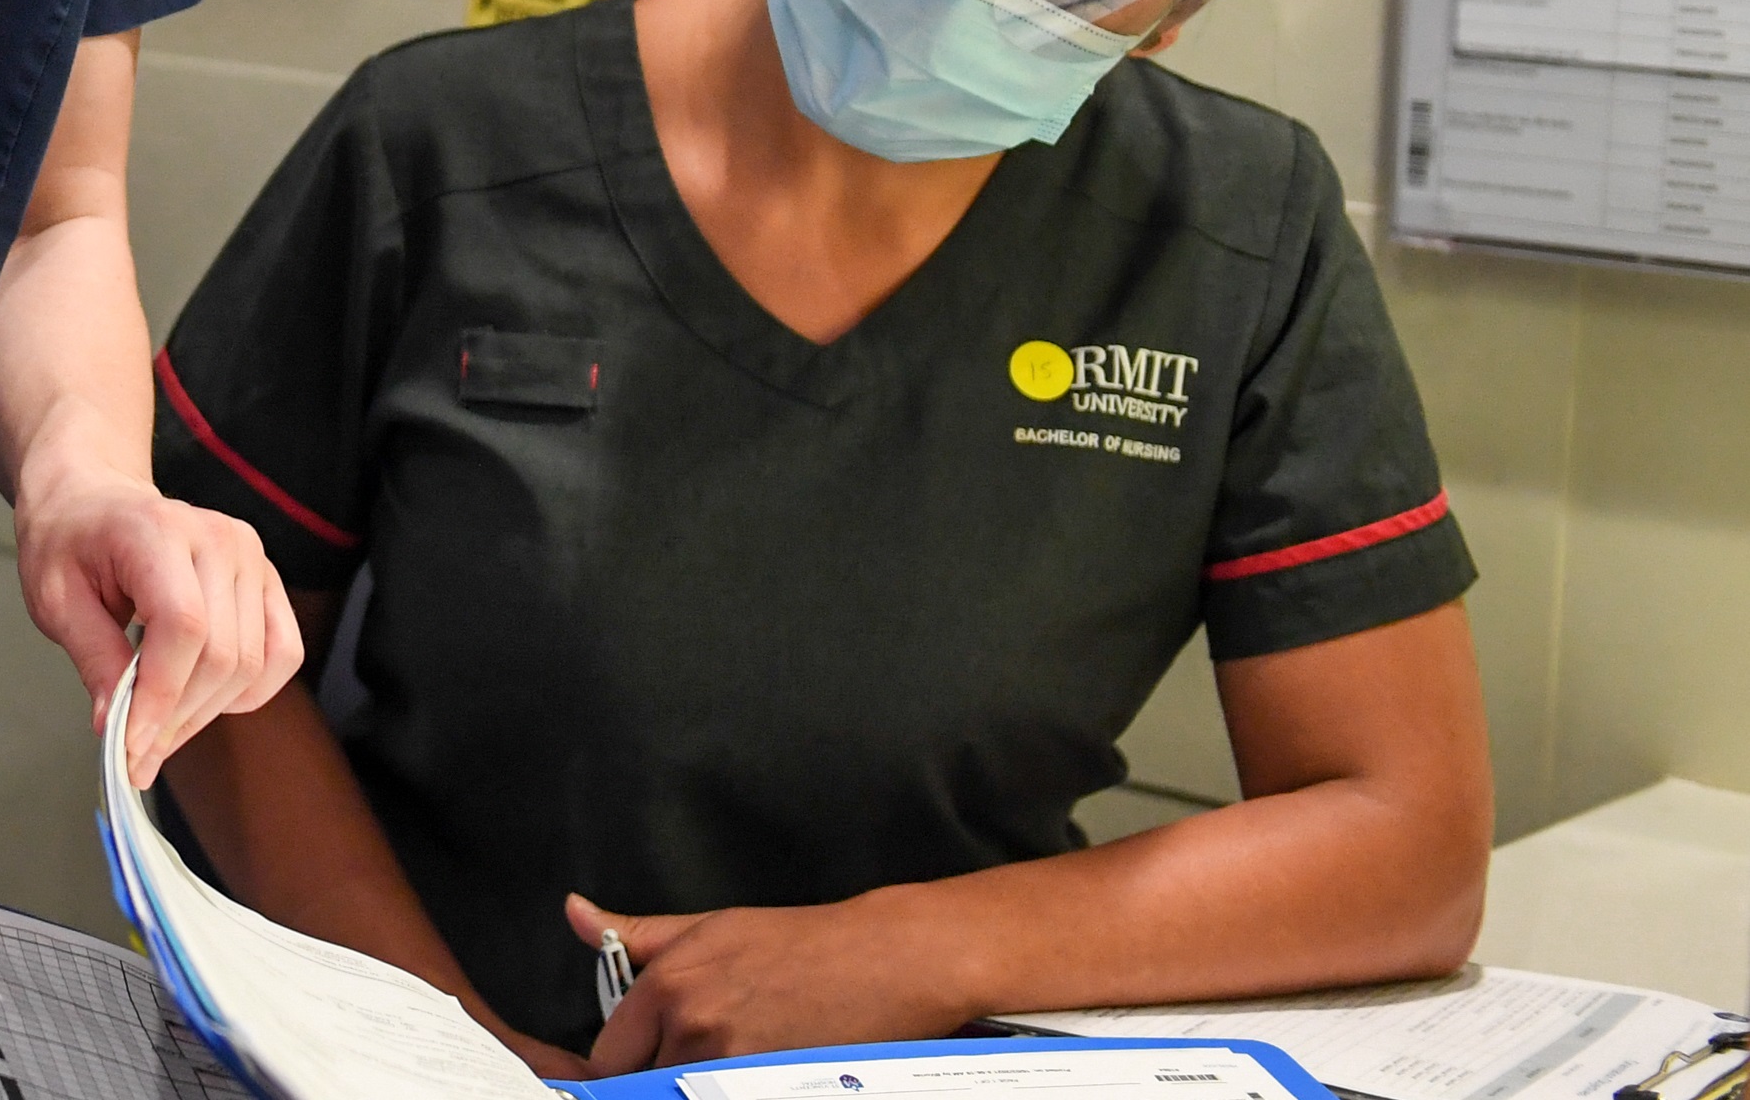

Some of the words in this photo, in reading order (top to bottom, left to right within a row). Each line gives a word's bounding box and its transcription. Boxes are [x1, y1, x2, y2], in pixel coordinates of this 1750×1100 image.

[1069, 344, 1199, 403] RMIT
[1072, 391, 1189, 428] UNIVERSITY
[1013, 427, 1100, 449] BACHELOR
[1104, 434, 1122, 452] OF
[1122, 438, 1181, 464] NURSING
